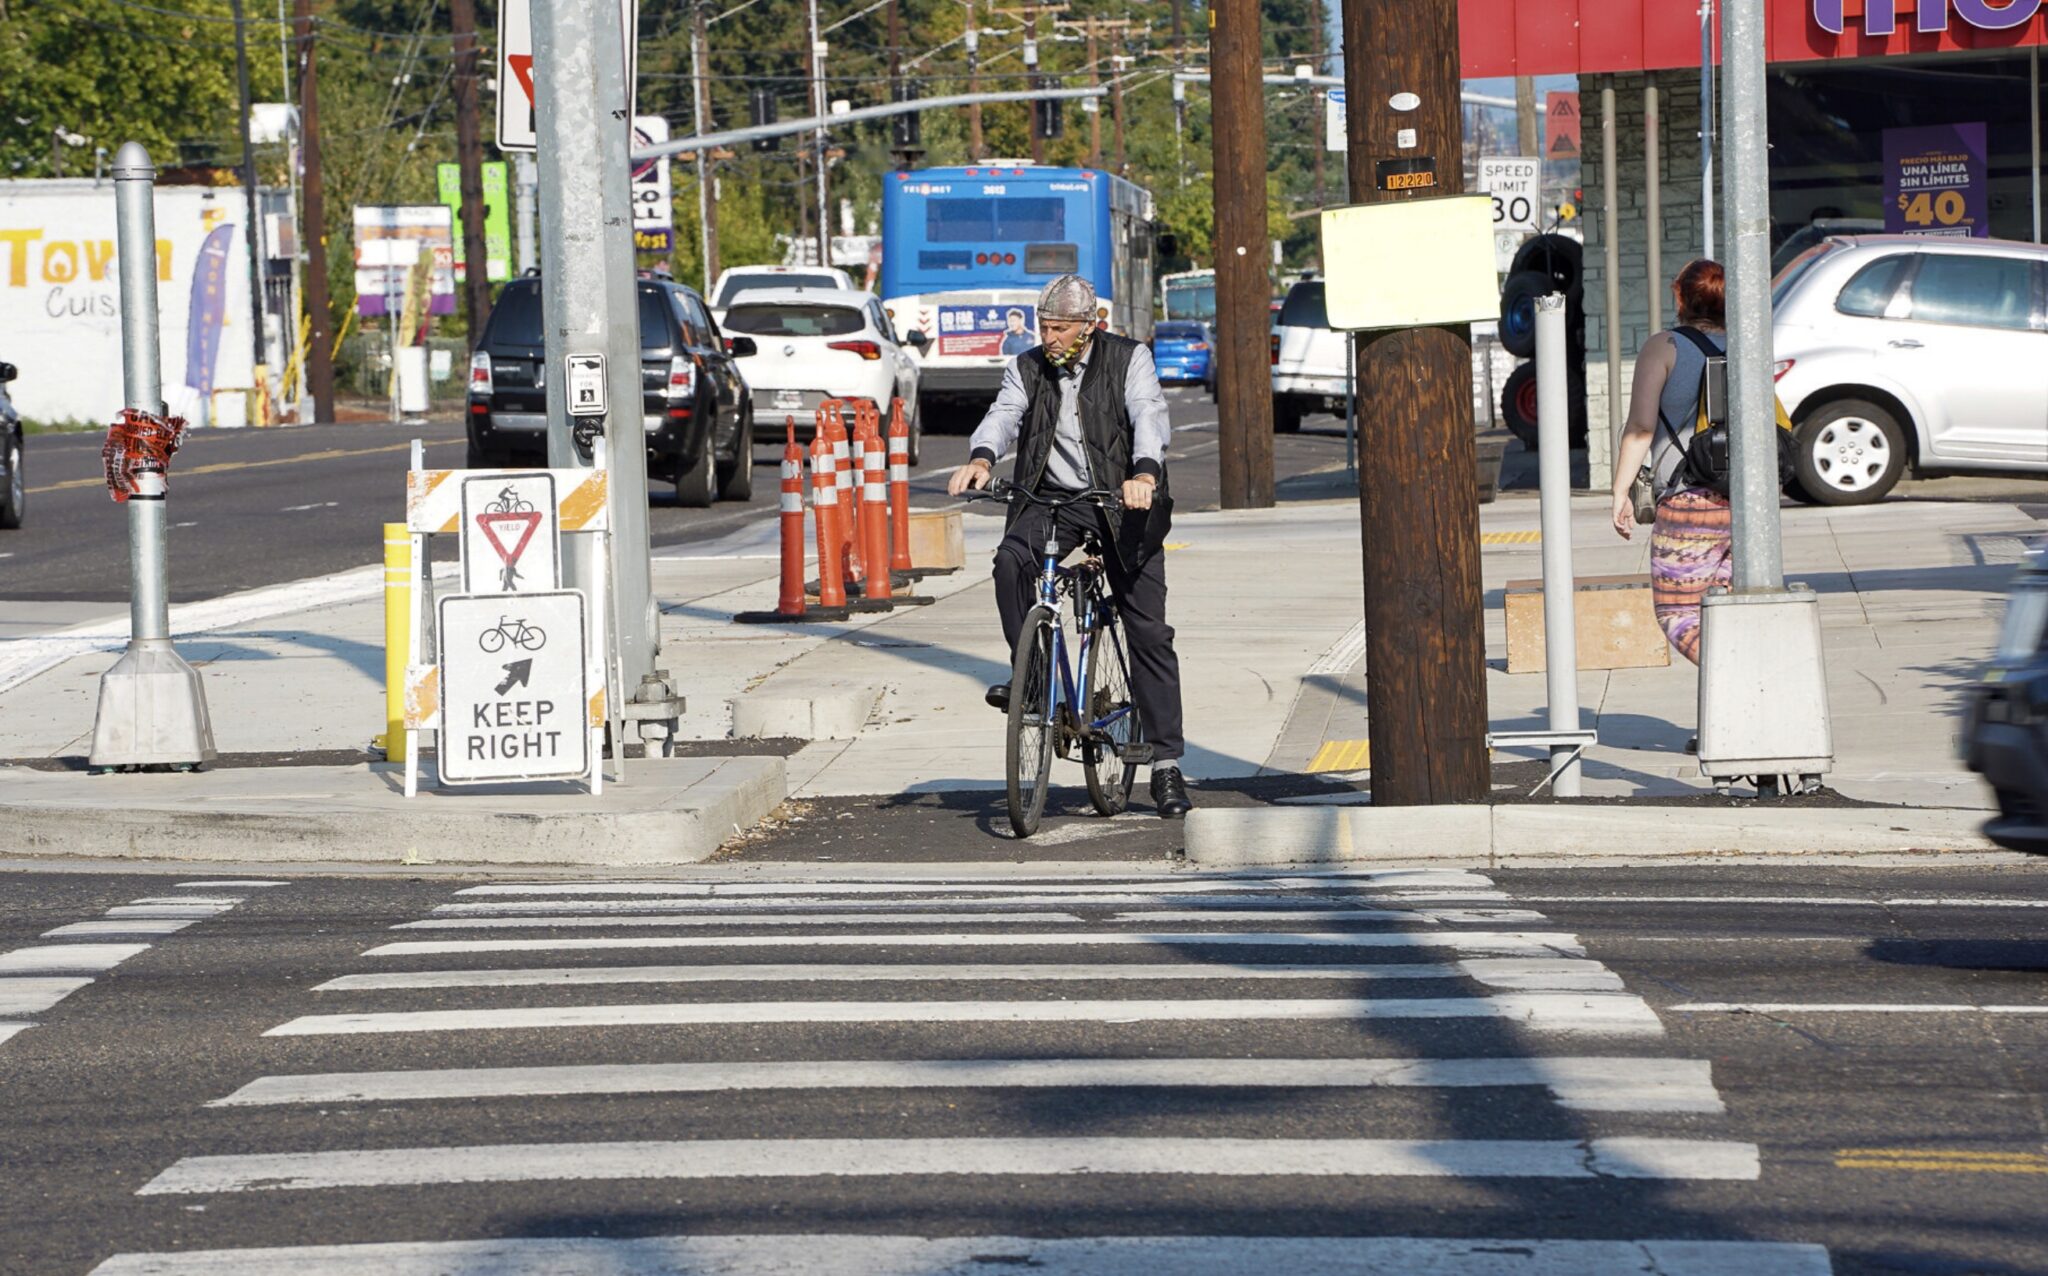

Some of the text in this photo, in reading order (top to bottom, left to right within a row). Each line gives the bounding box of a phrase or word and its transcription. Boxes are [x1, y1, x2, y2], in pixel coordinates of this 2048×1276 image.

[1485, 164, 1533, 177] SPEED
[1902, 162, 1967, 176] UNA LÍNEA
[1390, 173, 1432, 188] 12220
[1490, 181, 1528, 192] LIMIT
[1900, 174, 1970, 187] SIN LÍMITES
[1491, 197, 1531, 223] 30
[1898, 190, 1966, 225] $40
[46, 286, 162, 318] Cuis
[499, 523, 520, 531] YIELD
[473, 700, 555, 728] KEEP
[467, 731, 562, 760] RIGHT
